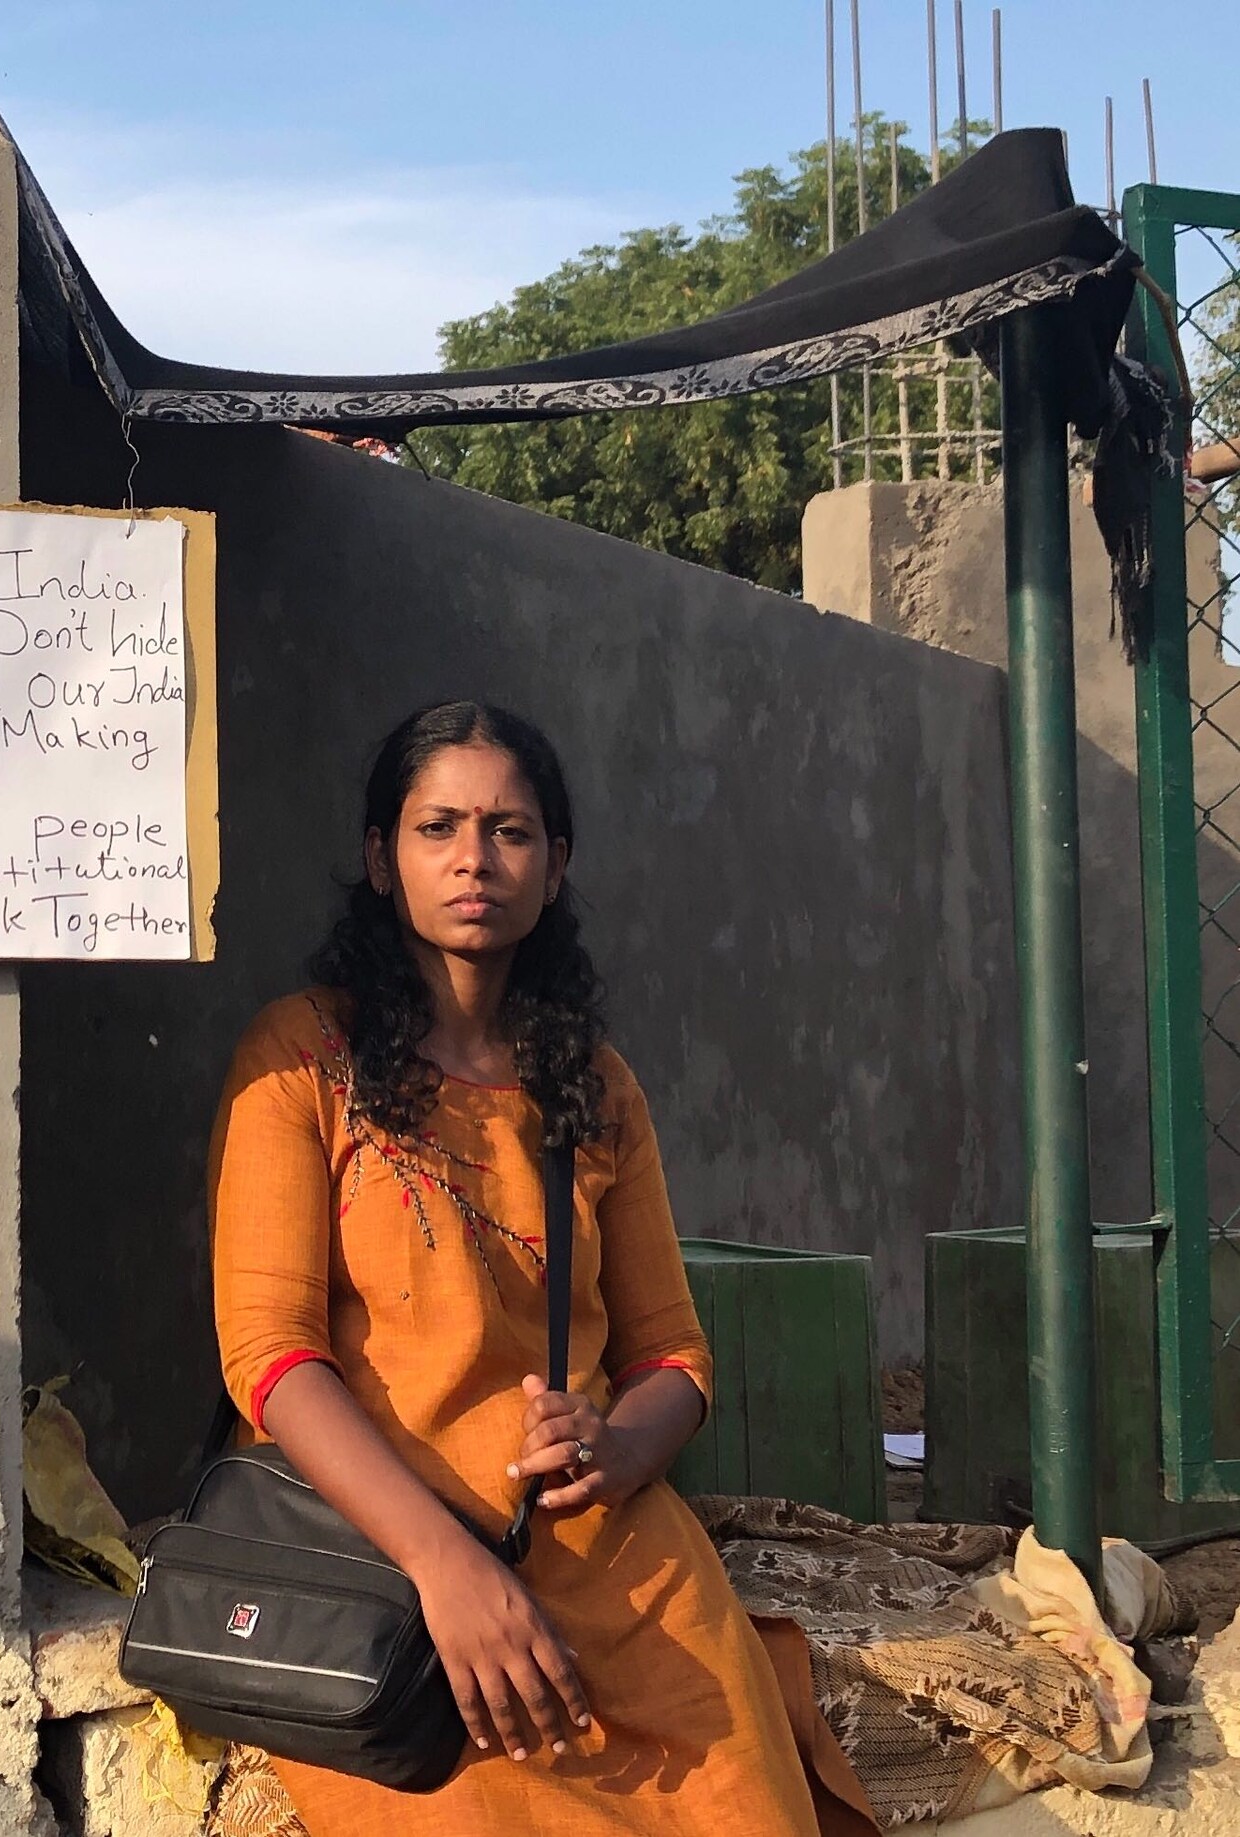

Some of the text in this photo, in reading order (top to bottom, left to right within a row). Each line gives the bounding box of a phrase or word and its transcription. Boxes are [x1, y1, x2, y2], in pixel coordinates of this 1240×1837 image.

[110, 602, 179, 657] hide
[27, 672, 105, 709] Our
[110, 665, 185, 704] India
[2, 709, 159, 770] Making
[31, 893, 188, 951] Together
